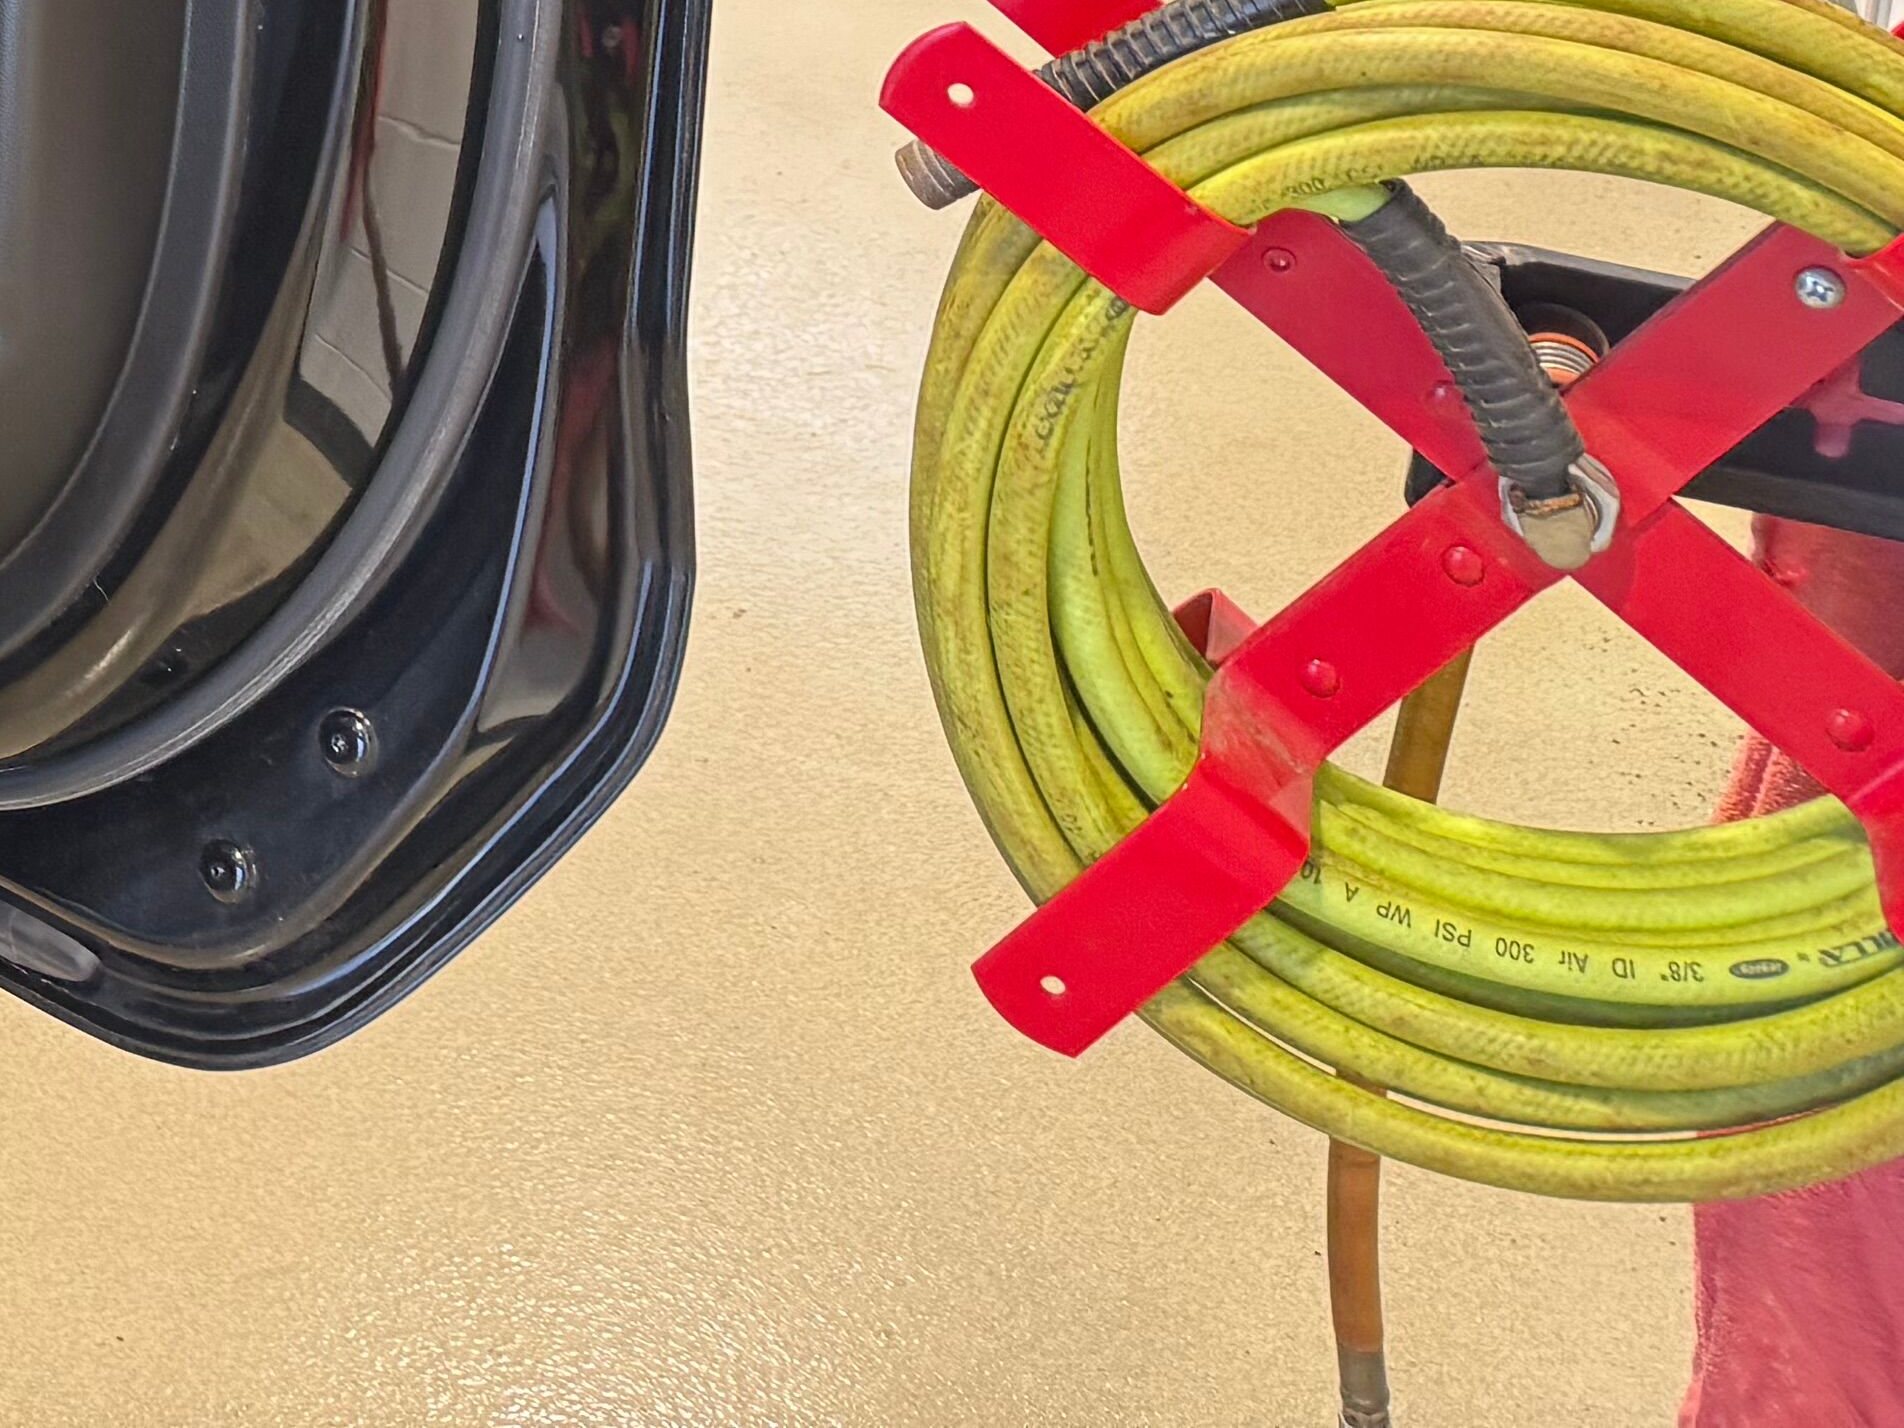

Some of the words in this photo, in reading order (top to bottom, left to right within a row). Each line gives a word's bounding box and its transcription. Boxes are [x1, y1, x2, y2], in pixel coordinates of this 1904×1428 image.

[1344, 882, 1360, 903] A
[1376, 900, 1412, 929] WP
[1435, 919, 1472, 948] PSI
[1495, 937, 1535, 964] 300
[1557, 951, 1588, 974] Air
[1611, 957, 1636, 981] ID
[1659, 960, 1705, 983] 3/8"
